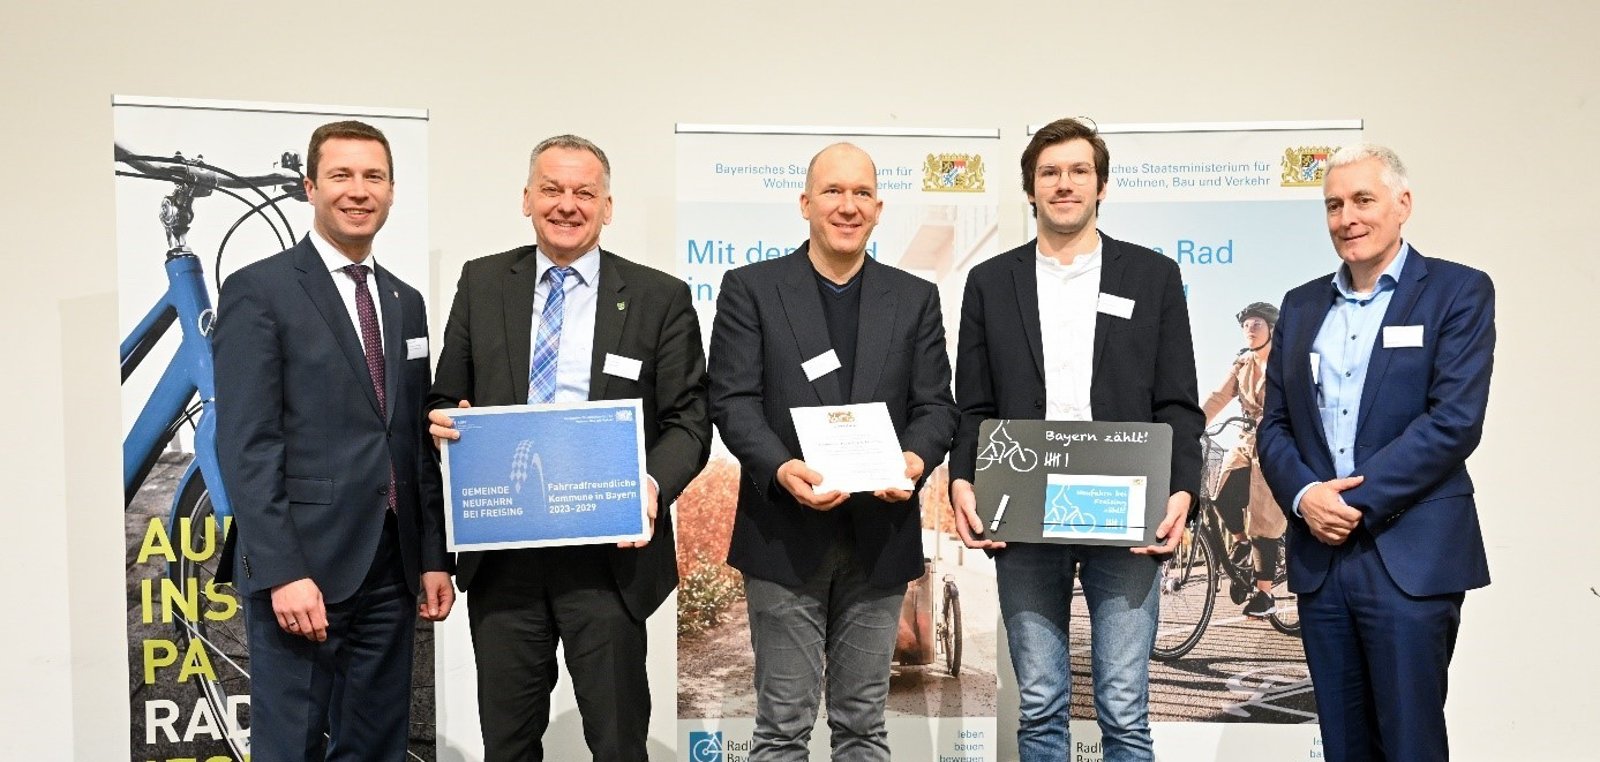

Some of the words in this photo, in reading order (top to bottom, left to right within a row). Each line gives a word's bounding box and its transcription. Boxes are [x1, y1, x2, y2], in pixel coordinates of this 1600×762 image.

[715, 163, 785, 176] Bayerisches
[896, 166, 913, 176] für
[1141, 162, 1250, 174] Staatsministerium
[1253, 160, 1271, 172] für
[763, 178, 805, 189] Wohne
[1116, 176, 1169, 189] Wohnen,
[1172, 176, 1195, 187] Bau
[1199, 176, 1222, 187] und
[1224, 175, 1271, 187] Verkehr
[688, 239, 735, 265] Mit
[1177, 239, 1233, 265] Rad
[1045, 430, 1098, 446] Bayern
[1104, 431, 1149, 443] zählt!
[462, 485, 510, 496] GEMEINDE
[548, 479, 636, 492] Fahrradfreundliche
[463, 496, 513, 508] NEUFAHRN
[548, 493, 593, 503] Kommune
[595, 491, 604, 501] in
[605, 490, 637, 503] Bayern
[463, 508, 479, 519] BEI
[480, 507, 523, 518] FREISING
[549, 503, 597, 514] 2023-2029
[137, 515, 234, 563] AU
[141, 578, 238, 624] INS
[143, 638, 218, 685] PA
[957, 729, 985, 739] leben
